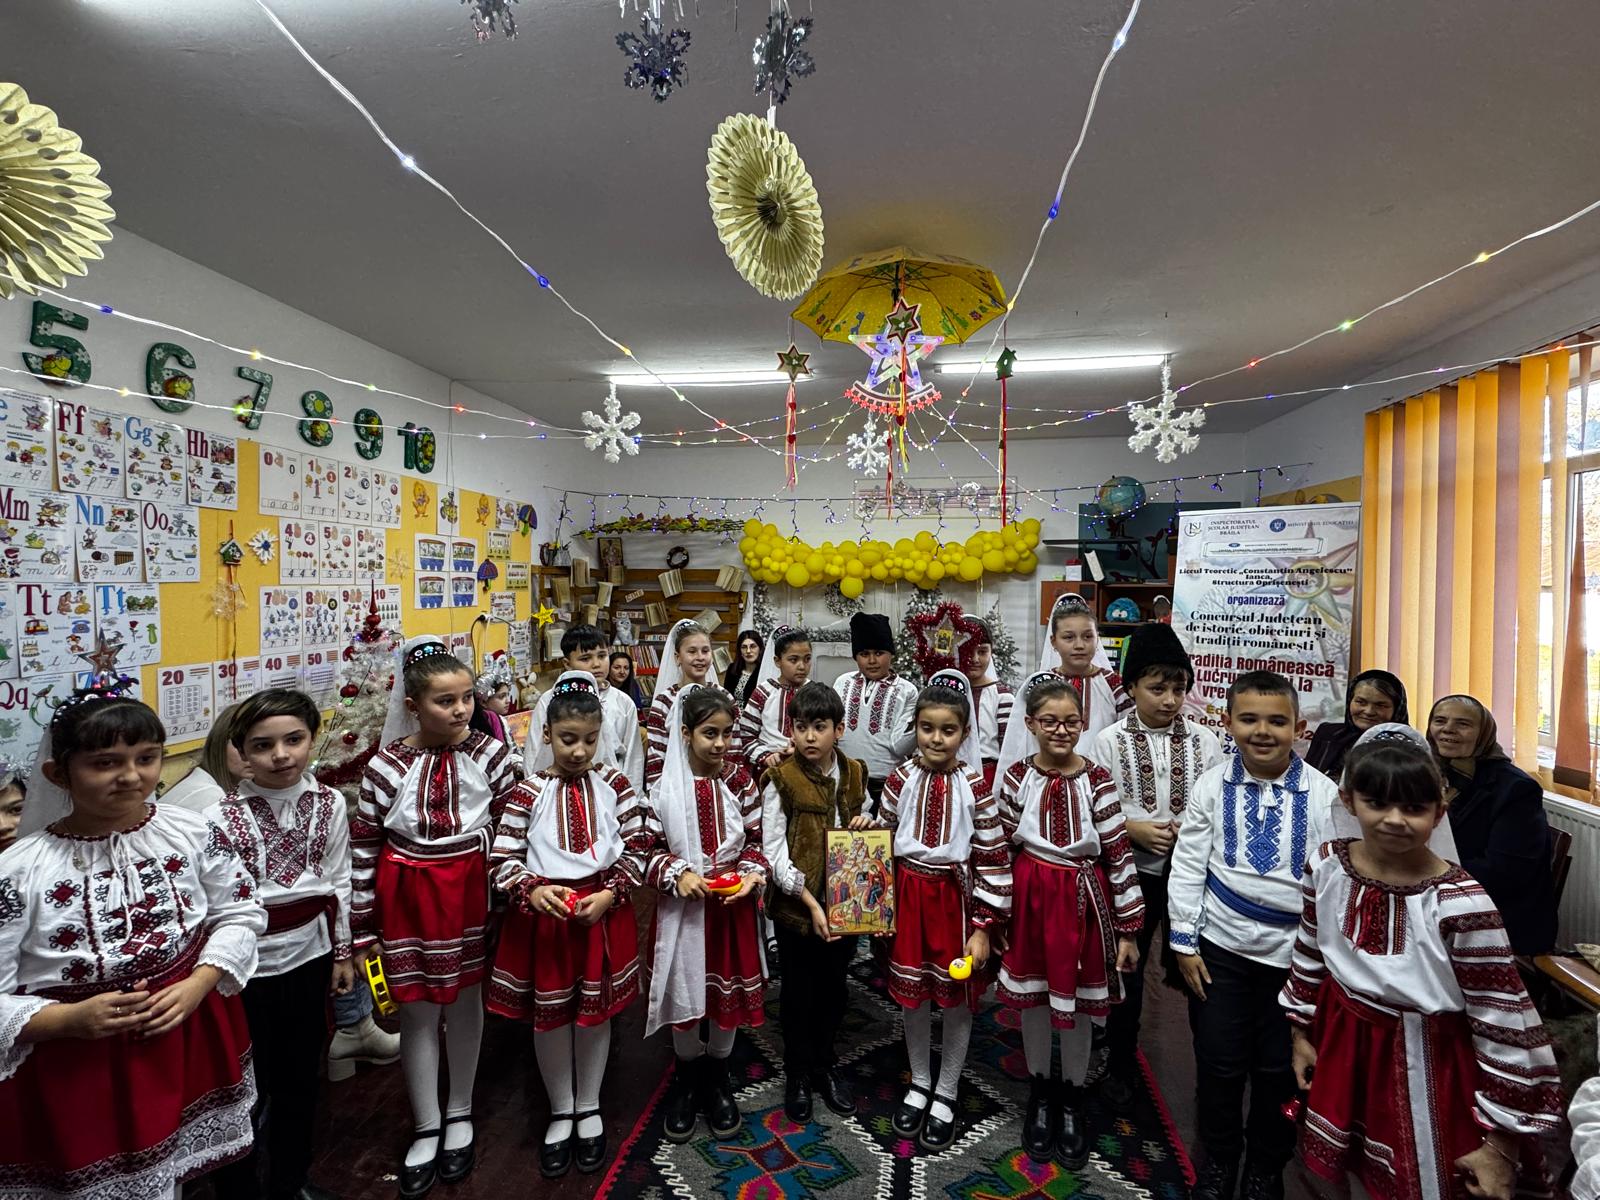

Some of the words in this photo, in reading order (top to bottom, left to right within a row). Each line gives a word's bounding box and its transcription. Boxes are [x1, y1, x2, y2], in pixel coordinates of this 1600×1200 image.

[22, 300, 91, 388] 5
[146, 342, 196, 413] 6
[237, 366, 273, 430] 7
[301, 390, 334, 447] 8
[354, 408, 384, 460] 9
[397, 421, 436, 474] 10
[57, 400, 87, 435] Ff
[126, 416, 153, 447] Gg
[187, 428, 208, 459] Hh
[0, 487, 30, 521] Mm
[75, 494, 105, 526] Nn
[143, 502, 168, 530] Oo
[1256, 579, 1309, 589] Oprișenești
[17, 584, 52, 616] Tt
[1227, 594, 1286, 608] organizează
[1190, 610, 1255, 623] Concursul
[1257, 613, 1323, 627] Județean
[1185, 622, 1201, 632] de
[1248, 627, 1311, 638] obiceiuri
[1314, 628, 1327, 641] și
[1195, 635, 1241, 648] tradiții
[1243, 637, 1315, 653] românești
[218, 663, 239, 678] 30
[265, 657, 282, 671] 40
[307, 652, 322, 666] 50
[1187, 653, 1233, 669] radiția
[1236, 655, 1336, 678] Românească
[162, 669, 184, 686] 20
[1197, 668, 1240, 685] Lucru
[1298, 677, 1314, 693] la
